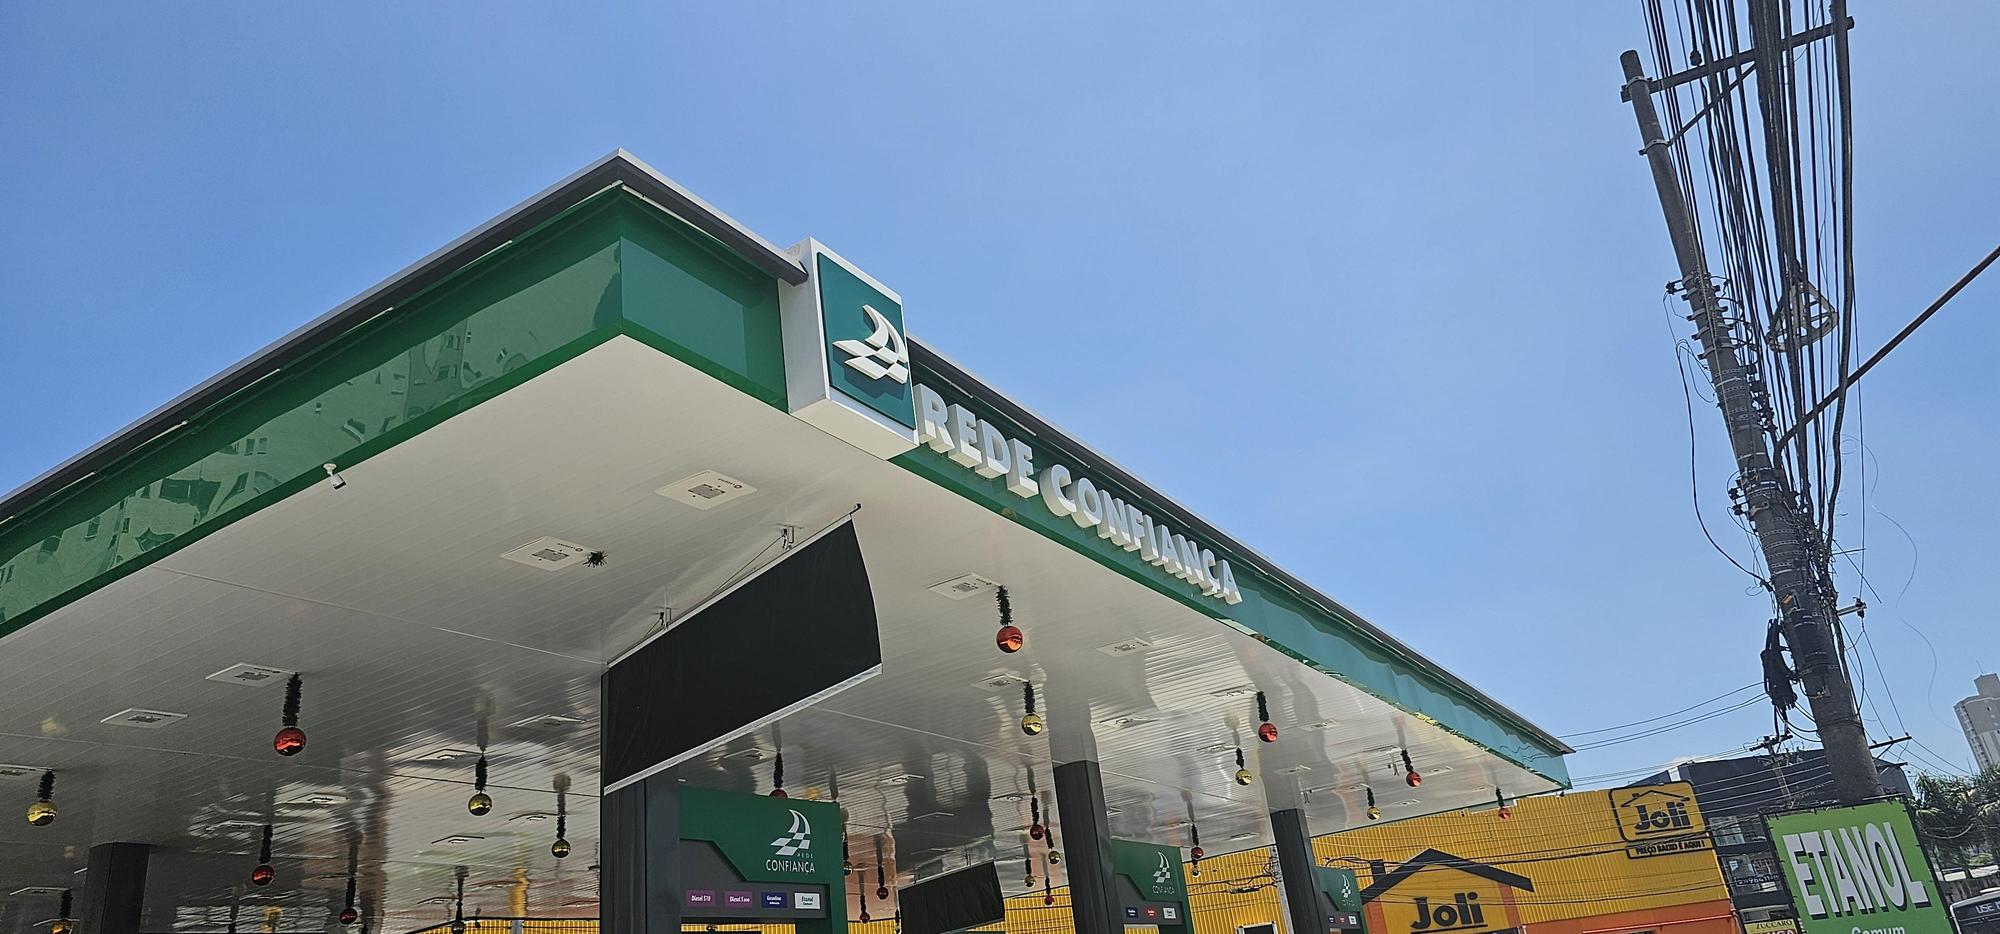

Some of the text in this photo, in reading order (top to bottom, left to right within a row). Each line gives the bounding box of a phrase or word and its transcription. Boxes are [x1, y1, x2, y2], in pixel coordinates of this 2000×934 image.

[913, 383, 1242, 605] REDE CONFIANÇA
[1635, 801, 1690, 830] Joli
[1782, 822, 1931, 917] ETANOL
[1410, 891, 1484, 930] Joli
[1756, 919, 1793, 930] ZUCCARO
[1975, 902, 1995, 914] USE
